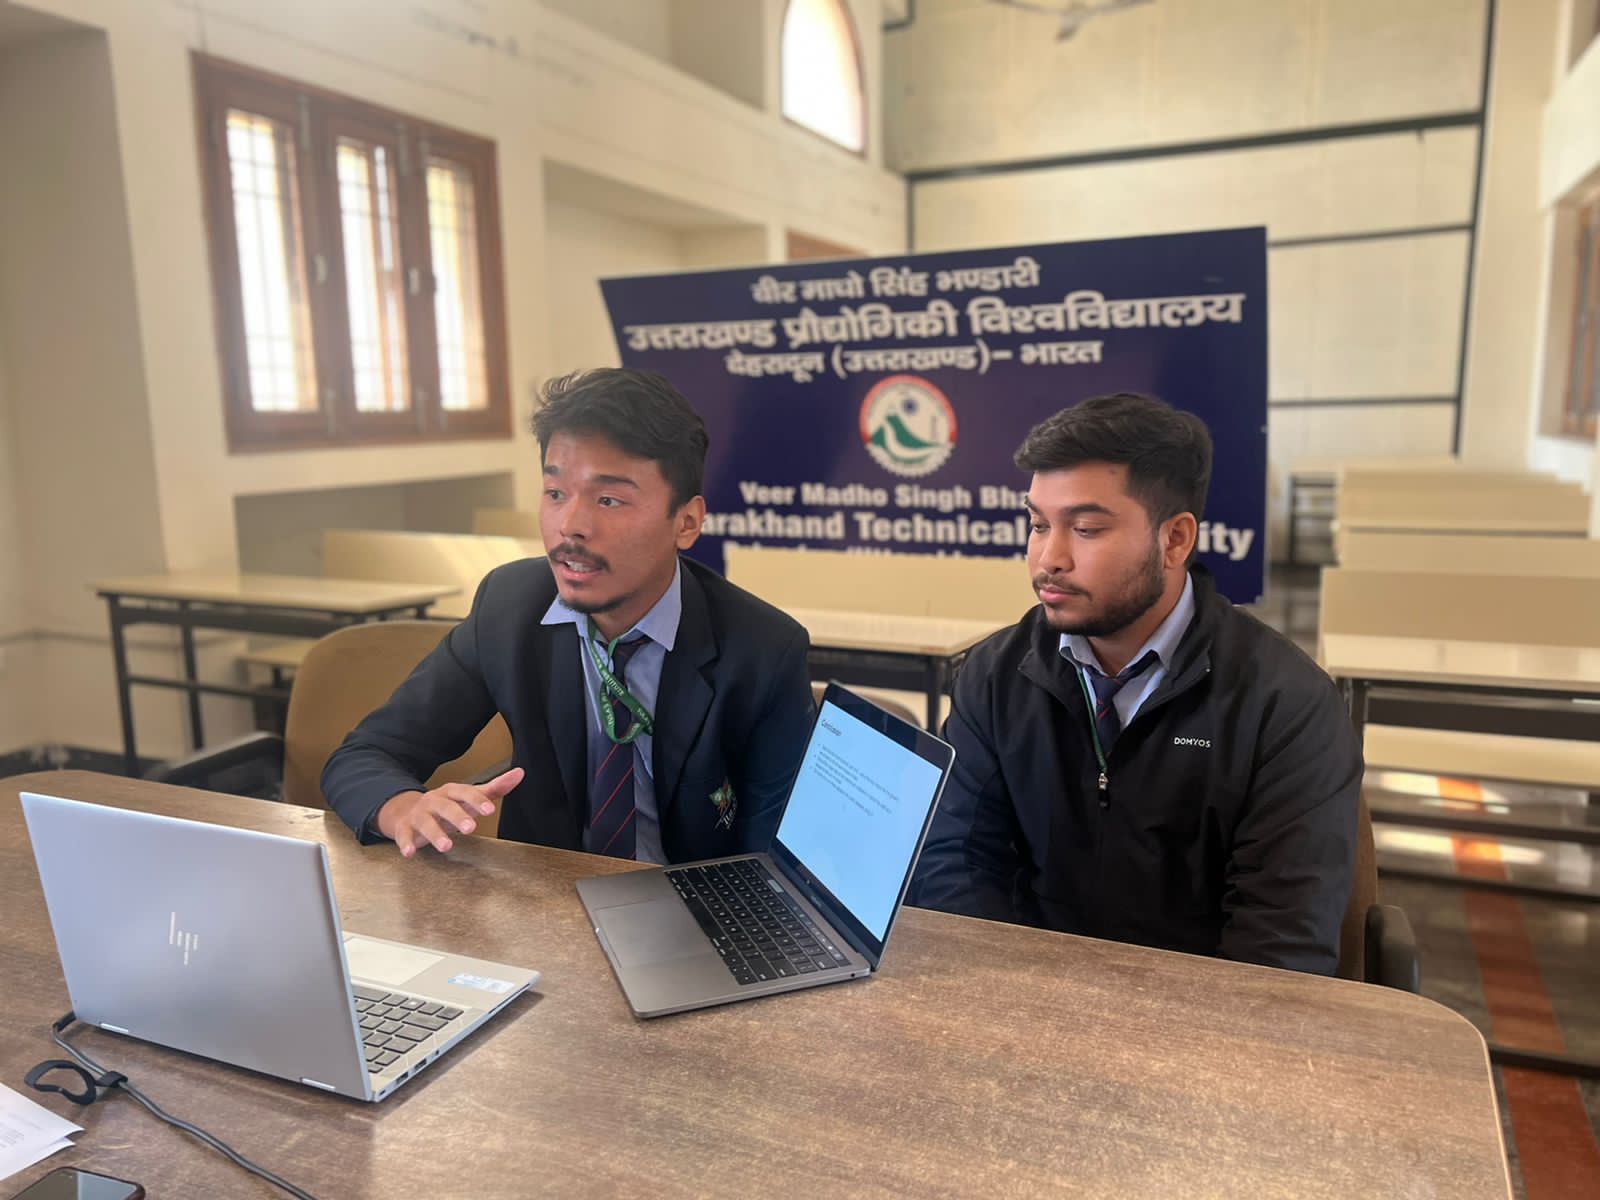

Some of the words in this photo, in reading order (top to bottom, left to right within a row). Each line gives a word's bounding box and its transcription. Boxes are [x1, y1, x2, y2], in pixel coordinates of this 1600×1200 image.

[751, 275, 798, 303] वीर
[801, 270, 865, 301] माधो
[870, 267, 930, 297] सिंह
[936, 256, 1041, 291] भण्डारी
[624, 319, 777, 351] उत्तराखण्ड
[967, 291, 1246, 335] विश्वविद्यालय
[725, 349, 825, 383] देहरादून
[1020, 341, 1104, 365] भारत
[739, 481, 796, 504] Veer
[801, 482, 889, 507] Madho
[895, 484, 972, 512] Singh
[701, 508, 845, 540] arakhand
[853, 511, 1027, 546] Technical
[1174, 736, 1211, 748] DOMYOS
